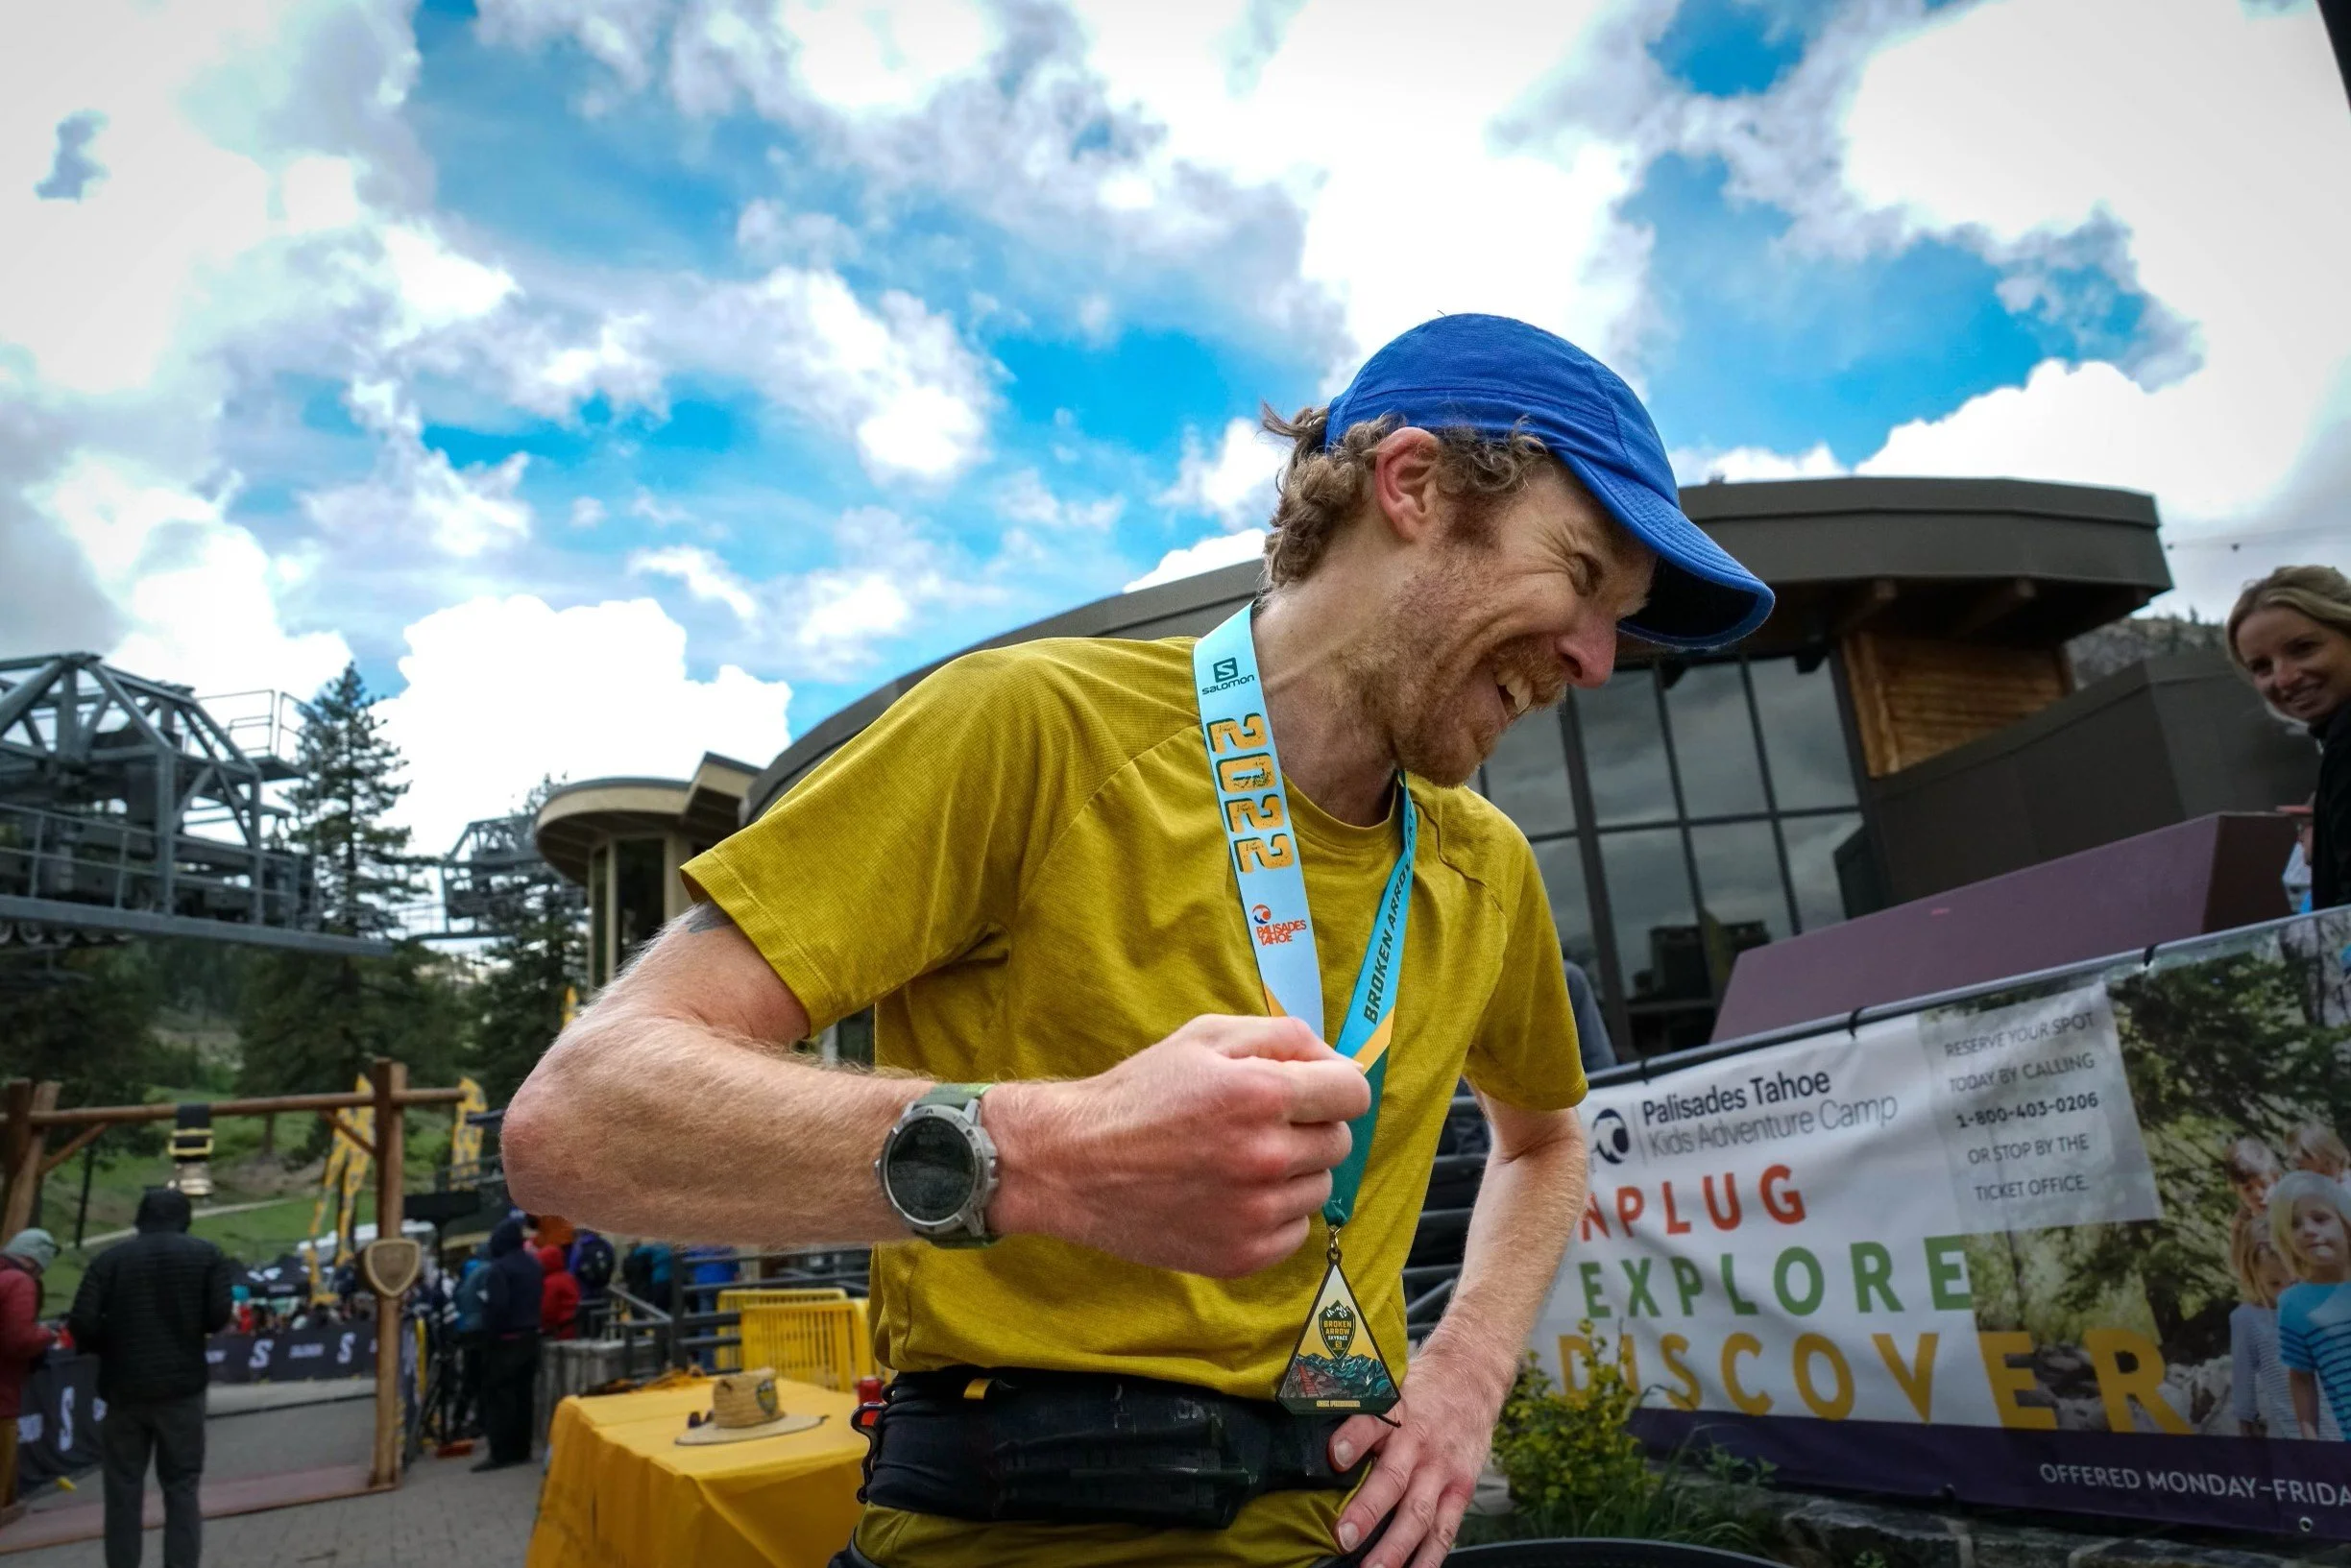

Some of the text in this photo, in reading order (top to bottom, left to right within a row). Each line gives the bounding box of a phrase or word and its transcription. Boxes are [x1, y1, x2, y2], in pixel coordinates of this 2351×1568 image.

[1205, 712, 1295, 875] 2022
[1256, 919, 1307, 938] PALISADES
[1261, 931, 1293, 946] TAHOE
[1364, 928, 1394, 1025] BROKEN
[1944, 1011, 2095, 1057] RESERVE YOUR SPOT
[1950, 1051, 2096, 1093] TODAY BY CALLING
[1642, 1069, 1830, 1126] Palisades Tahoe
[1955, 1091, 2099, 1129] 1-800-403-0206
[1647, 1095, 1899, 1159] Kids Adventure Camp
[1968, 1133, 2090, 1165] OR STOP BY THE
[1975, 1181, 2025, 1201] TICKET
[1578, 1235, 1974, 1318] EXPLORE
[1558, 1329, 2194, 1435] DISCOVER
[2039, 1462, 2142, 1490] OFFERED
